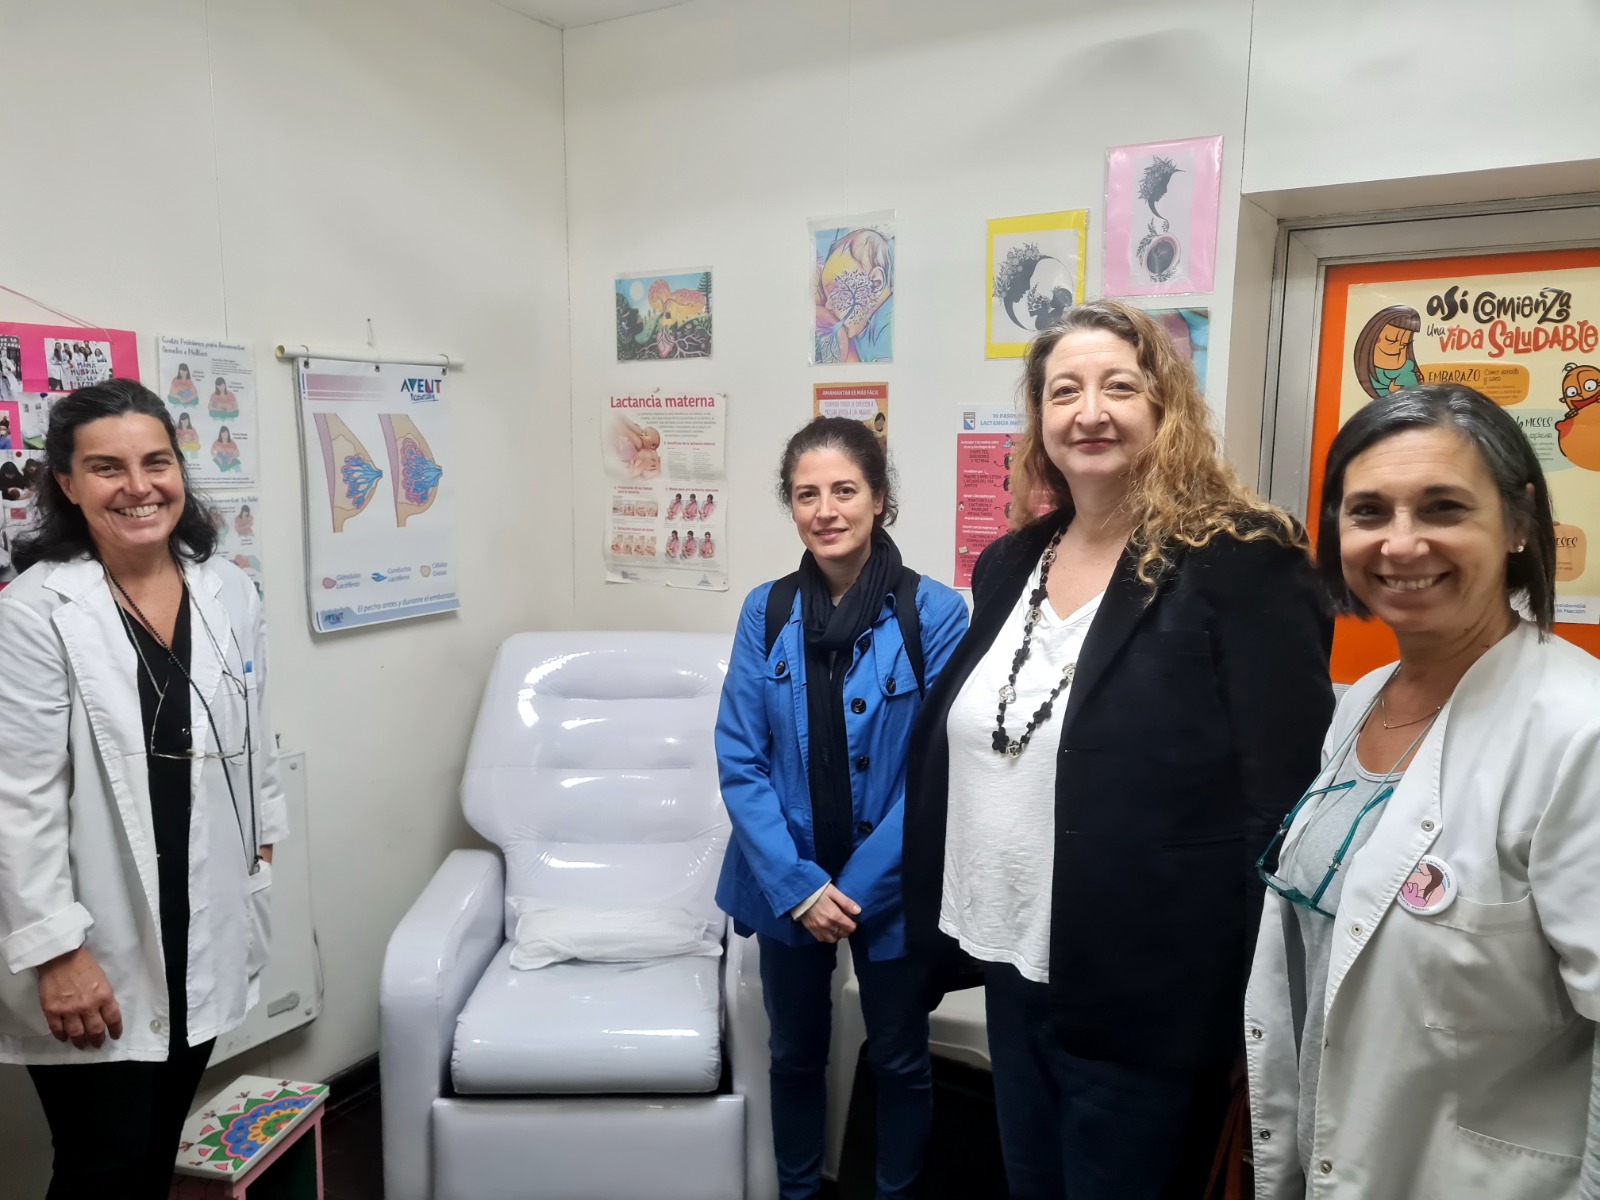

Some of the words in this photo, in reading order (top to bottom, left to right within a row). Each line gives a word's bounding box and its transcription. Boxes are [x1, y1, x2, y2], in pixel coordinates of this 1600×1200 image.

[1428, 368, 1480, 383] EMBARAZO
[400, 378, 442, 393] AVENT
[610, 394, 662, 408] Lactancia
[665, 395, 715, 408] materna
[1525, 417, 1554, 428] MESES
[1556, 537, 1578, 549] ESES
[357, 604, 364, 613] El
[364, 603, 382, 613] pecho
[382, 601, 398, 609] antes
[402, 596, 424, 607] durante
[429, 591, 456, 602] embarazo
